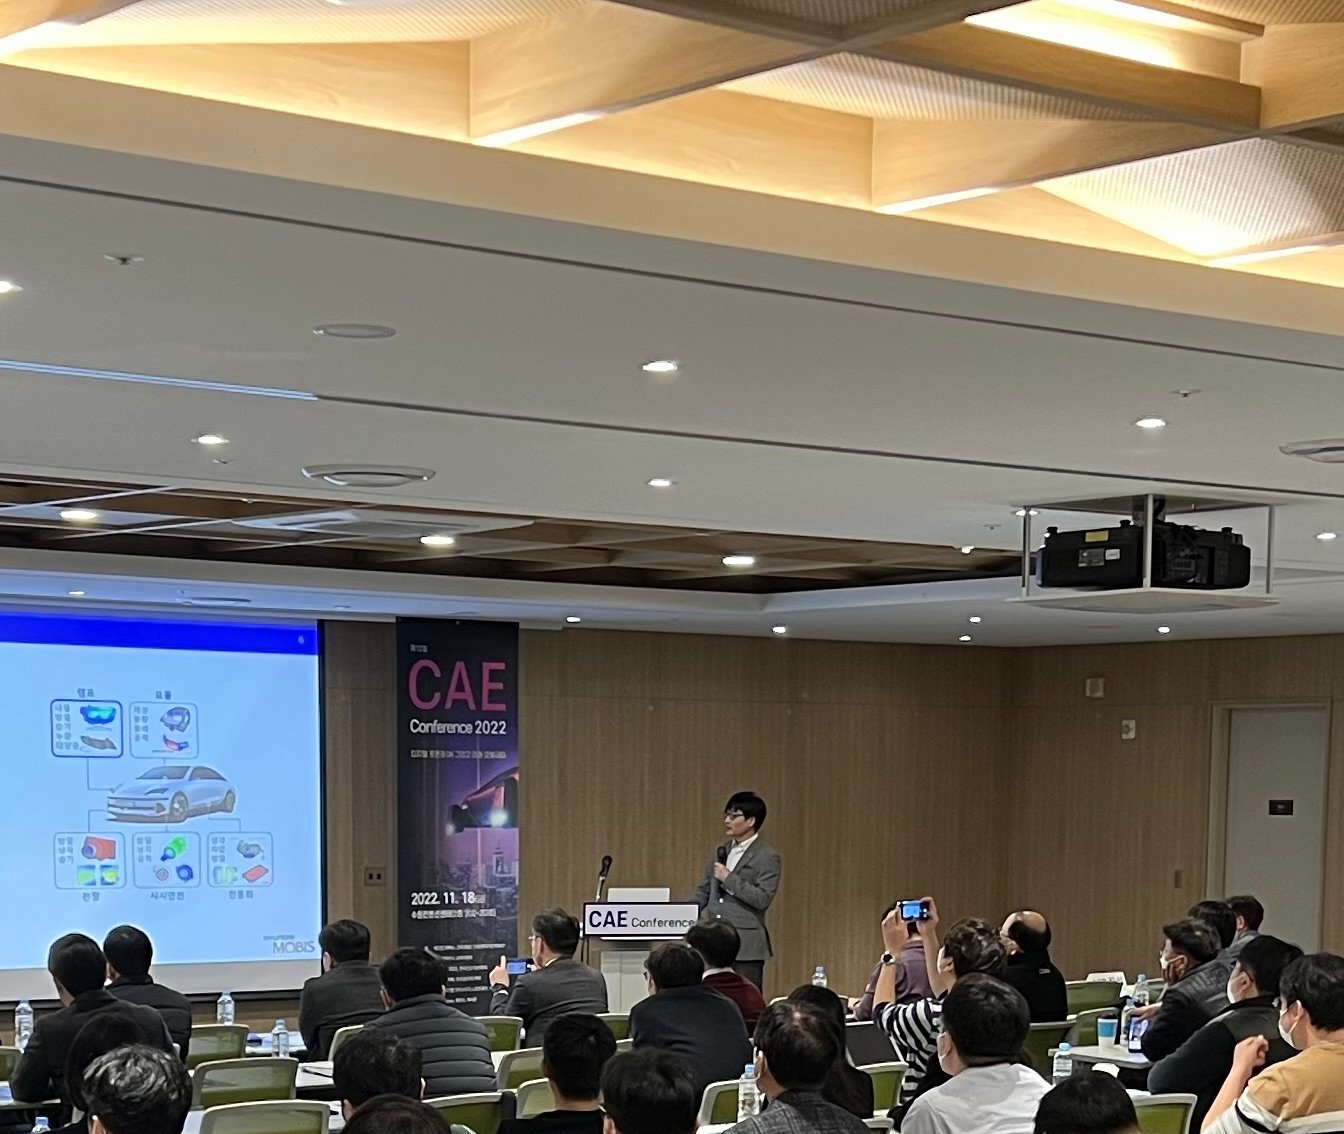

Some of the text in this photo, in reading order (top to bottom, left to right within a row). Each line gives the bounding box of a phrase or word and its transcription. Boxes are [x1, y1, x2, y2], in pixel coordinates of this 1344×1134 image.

[408, 658, 507, 711] CAE
[409, 718, 507, 735] Conference 2022
[411, 892, 441, 906] 2022.
[443, 891, 460, 905] 11.
[588, 910, 697, 928] CAE Conference
[272, 941, 316, 954] MOBIS
